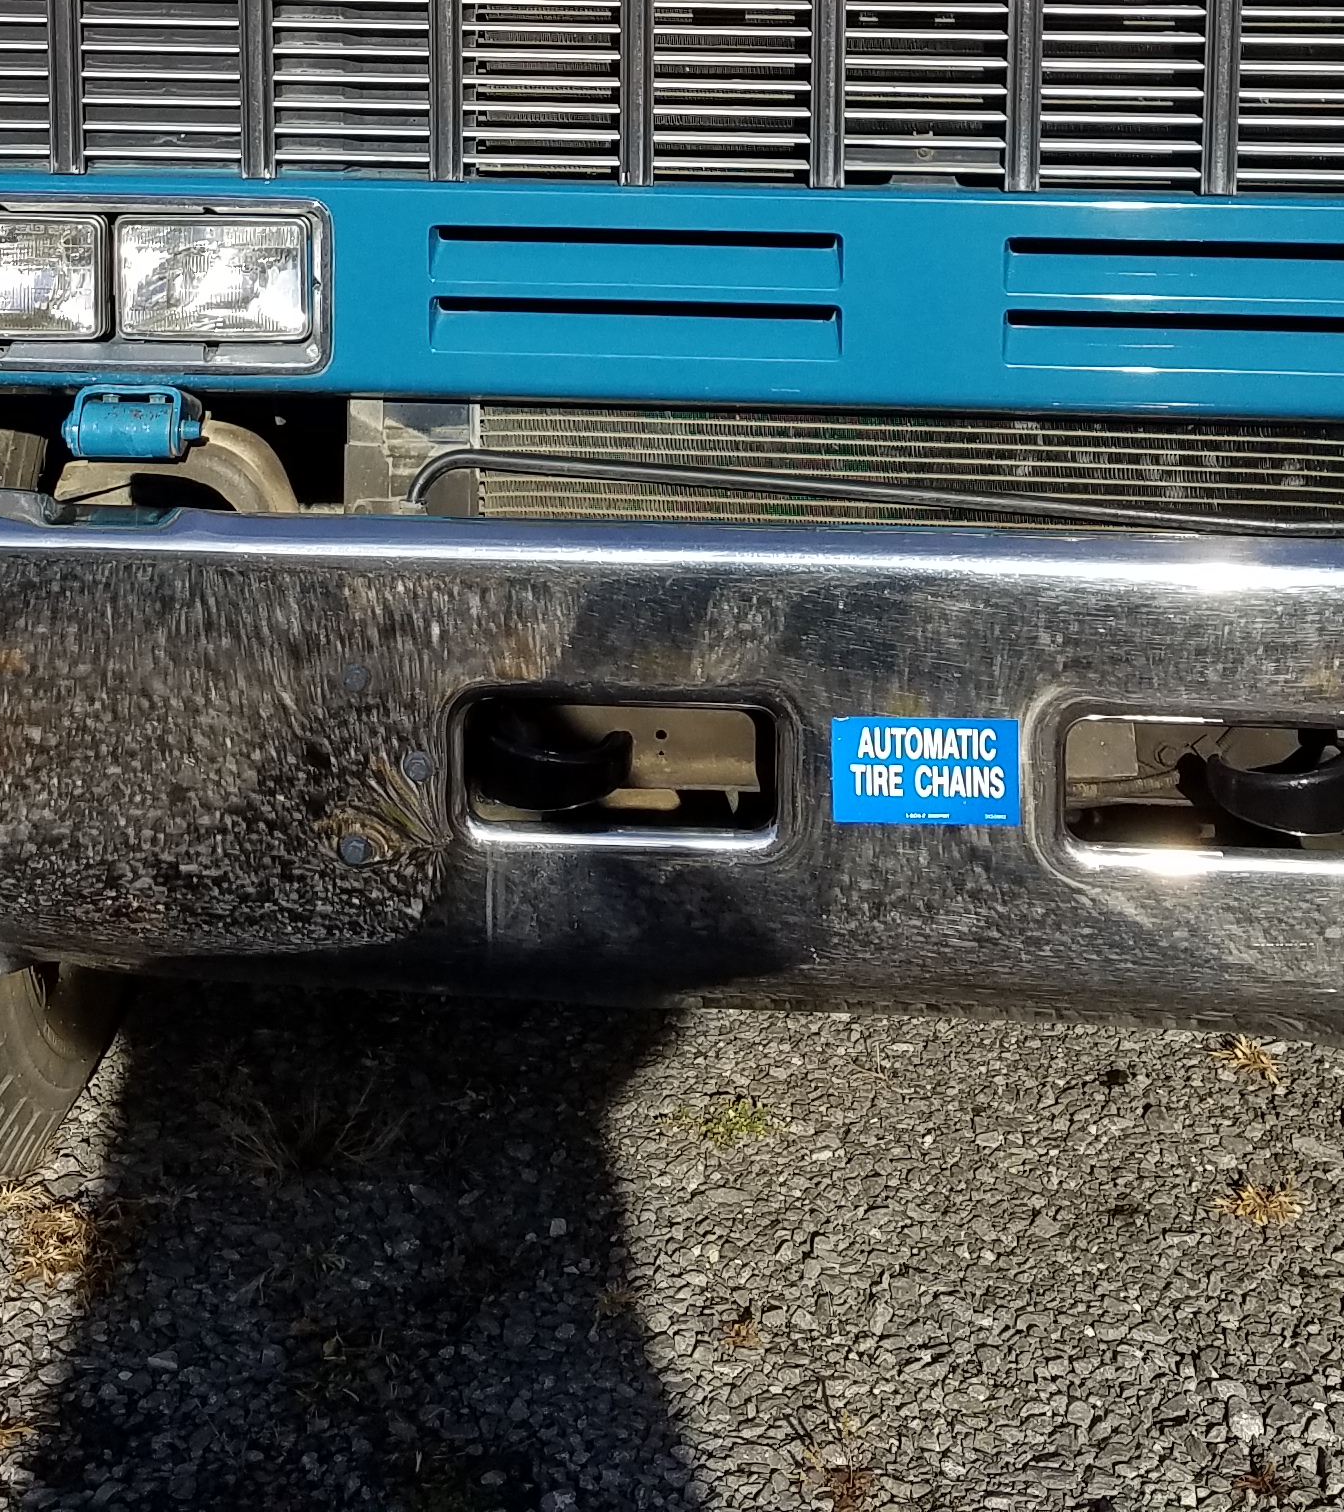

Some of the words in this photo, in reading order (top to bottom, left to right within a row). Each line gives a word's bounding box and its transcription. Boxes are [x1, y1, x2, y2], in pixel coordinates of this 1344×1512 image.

[857, 726, 997, 761] AUTOMATIC
[849, 763, 904, 797] TIRE
[914, 764, 1006, 799] CHAINS
